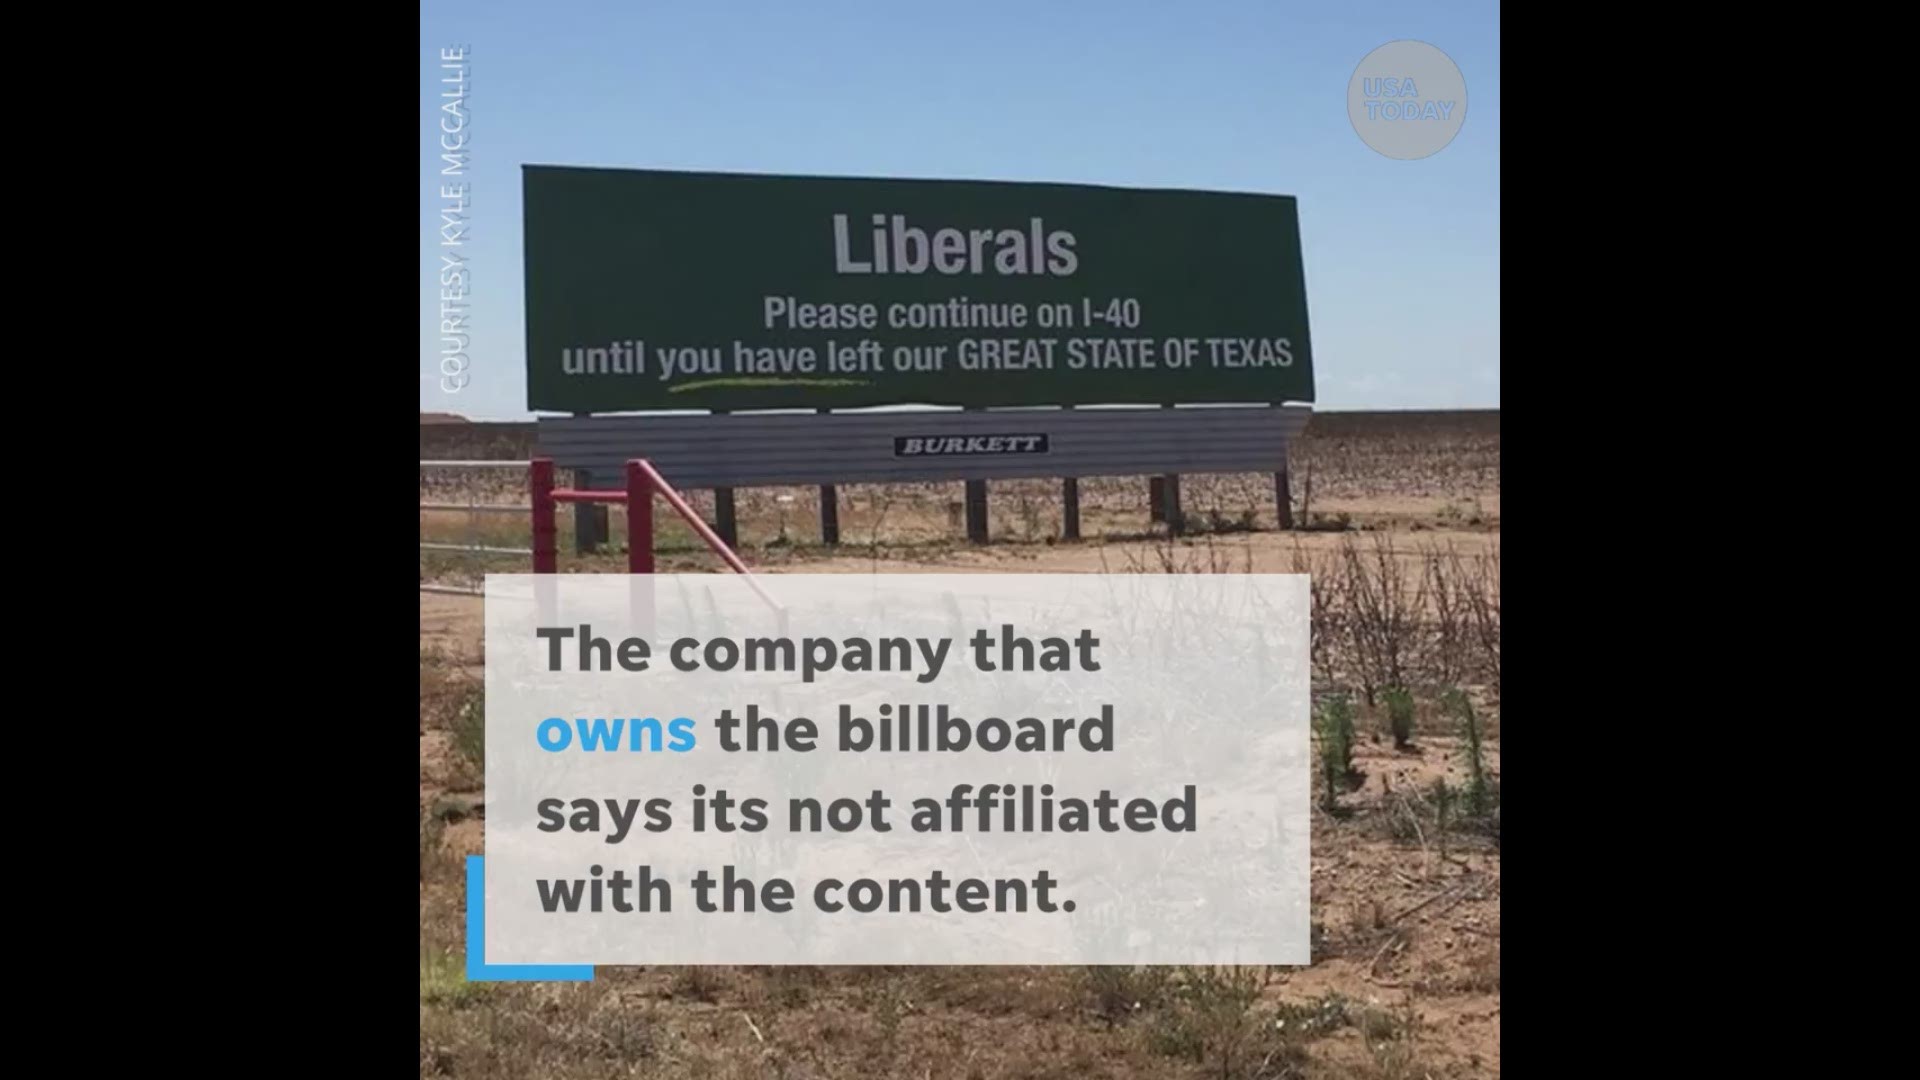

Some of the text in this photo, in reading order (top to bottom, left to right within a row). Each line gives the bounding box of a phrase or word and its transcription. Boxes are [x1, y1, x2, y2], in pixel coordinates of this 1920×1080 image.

[834, 214, 1077, 275] Liberals
[765, 297, 1139, 328] Please continue on I-40
[562, 338, 1292, 381] until you have left our GREAT STATE OF TEXAS
[903, 436, 1041, 454] BURKETT
